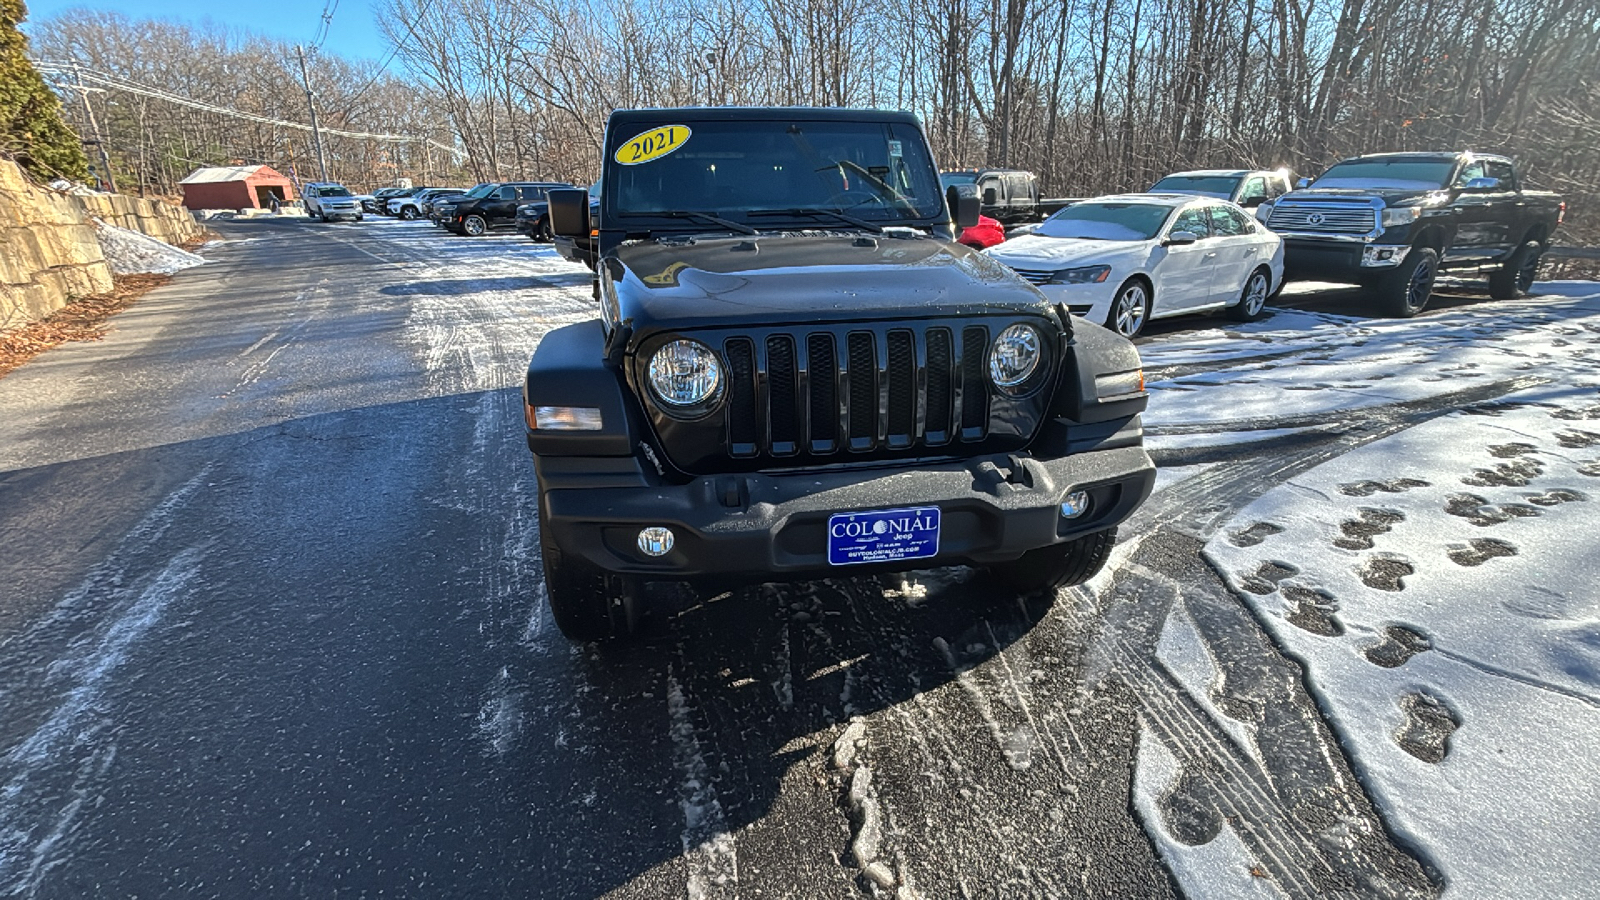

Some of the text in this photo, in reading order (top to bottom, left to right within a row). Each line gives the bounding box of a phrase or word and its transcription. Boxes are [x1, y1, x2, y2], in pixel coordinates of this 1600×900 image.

[630, 127, 676, 161] 2021
[831, 516, 937, 538] COLONIAL
[893, 533, 913, 541] Jeep
